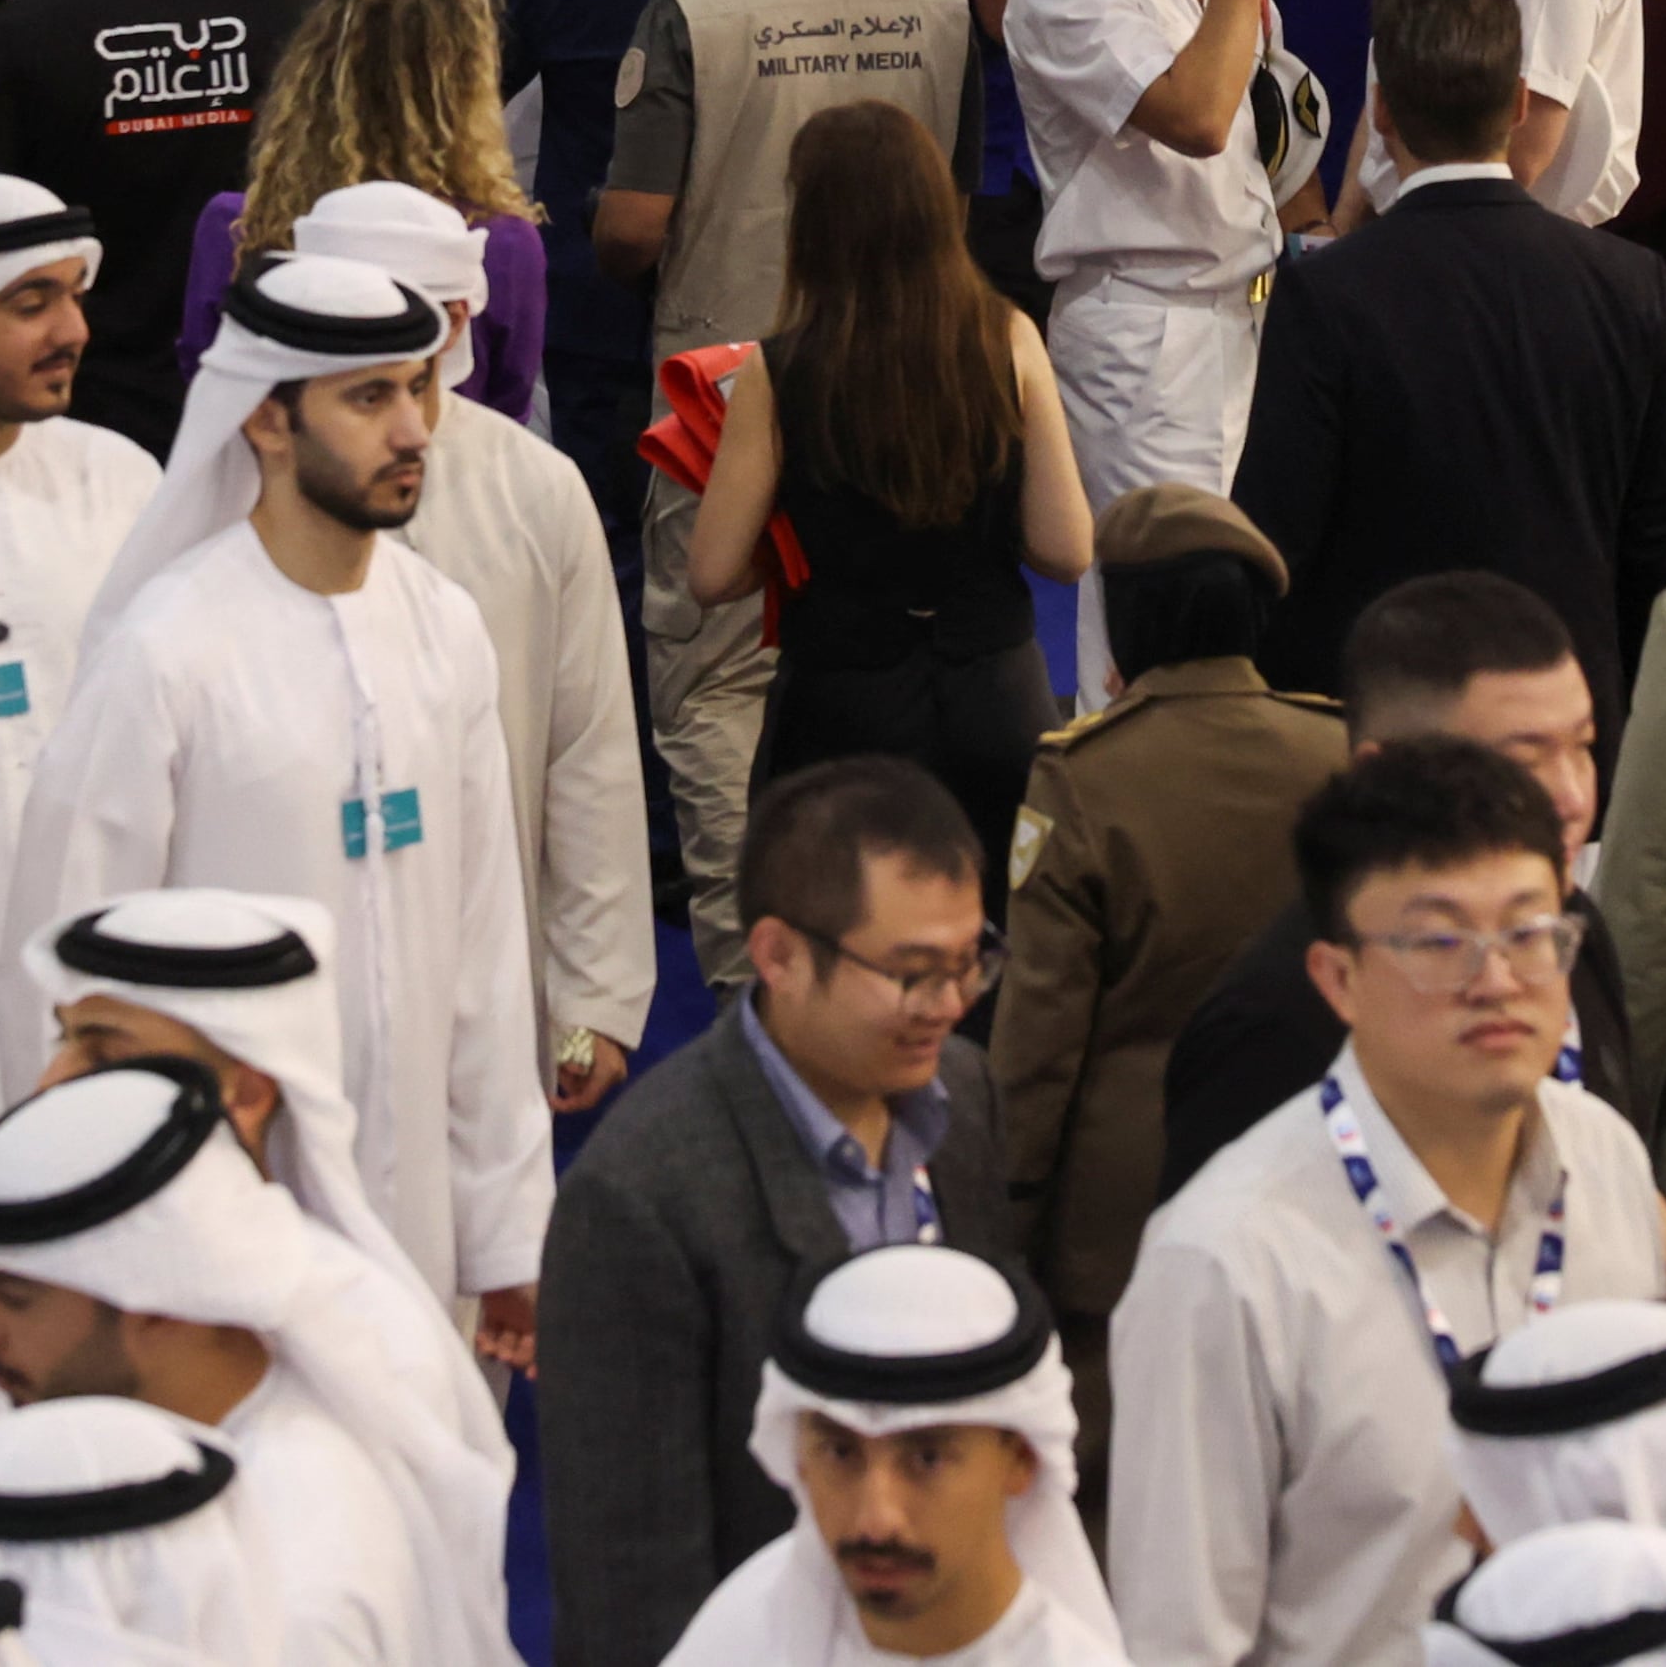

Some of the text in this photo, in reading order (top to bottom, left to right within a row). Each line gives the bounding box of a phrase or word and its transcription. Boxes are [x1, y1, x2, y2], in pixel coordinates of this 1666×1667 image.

[758, 51, 922, 77] MILITARY MEDIA
[118, 109, 239, 134] DUBAI MEDIA
